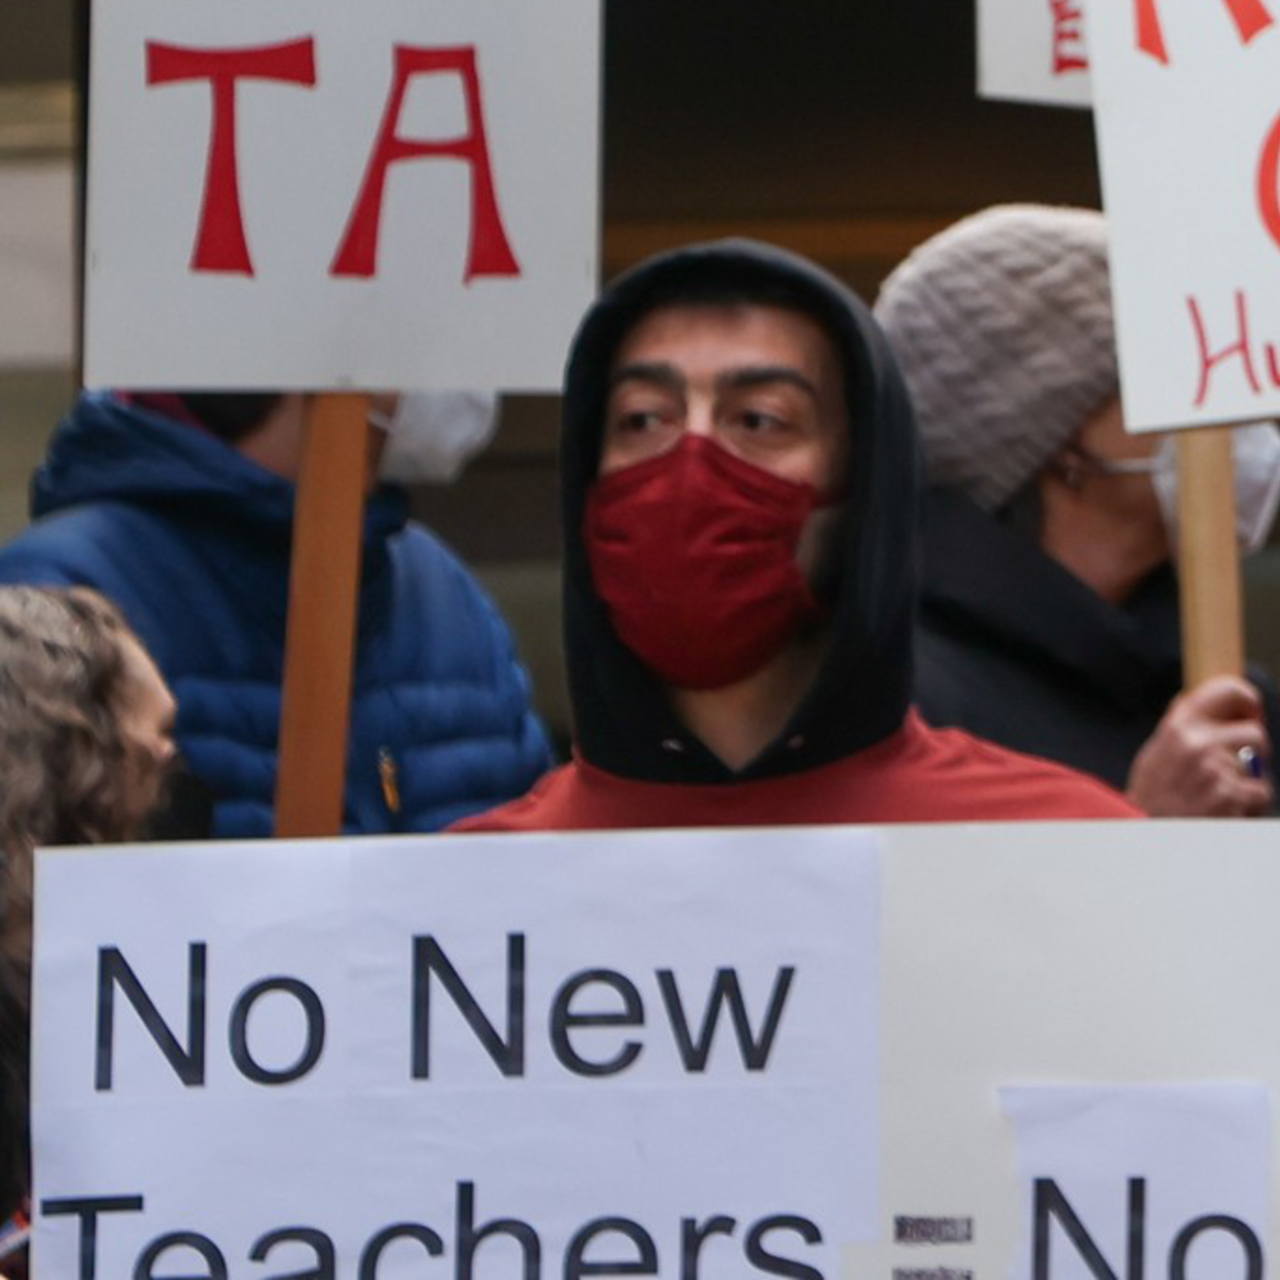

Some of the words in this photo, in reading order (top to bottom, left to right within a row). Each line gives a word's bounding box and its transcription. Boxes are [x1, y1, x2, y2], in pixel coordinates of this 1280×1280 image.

[146, 36, 520, 282] TA
[95, 942, 325, 1091] No
[411, 932, 795, 1080] New
[41, 1181, 825, 1280] Teachers
[1032, 1177, 1264, 1280] No
